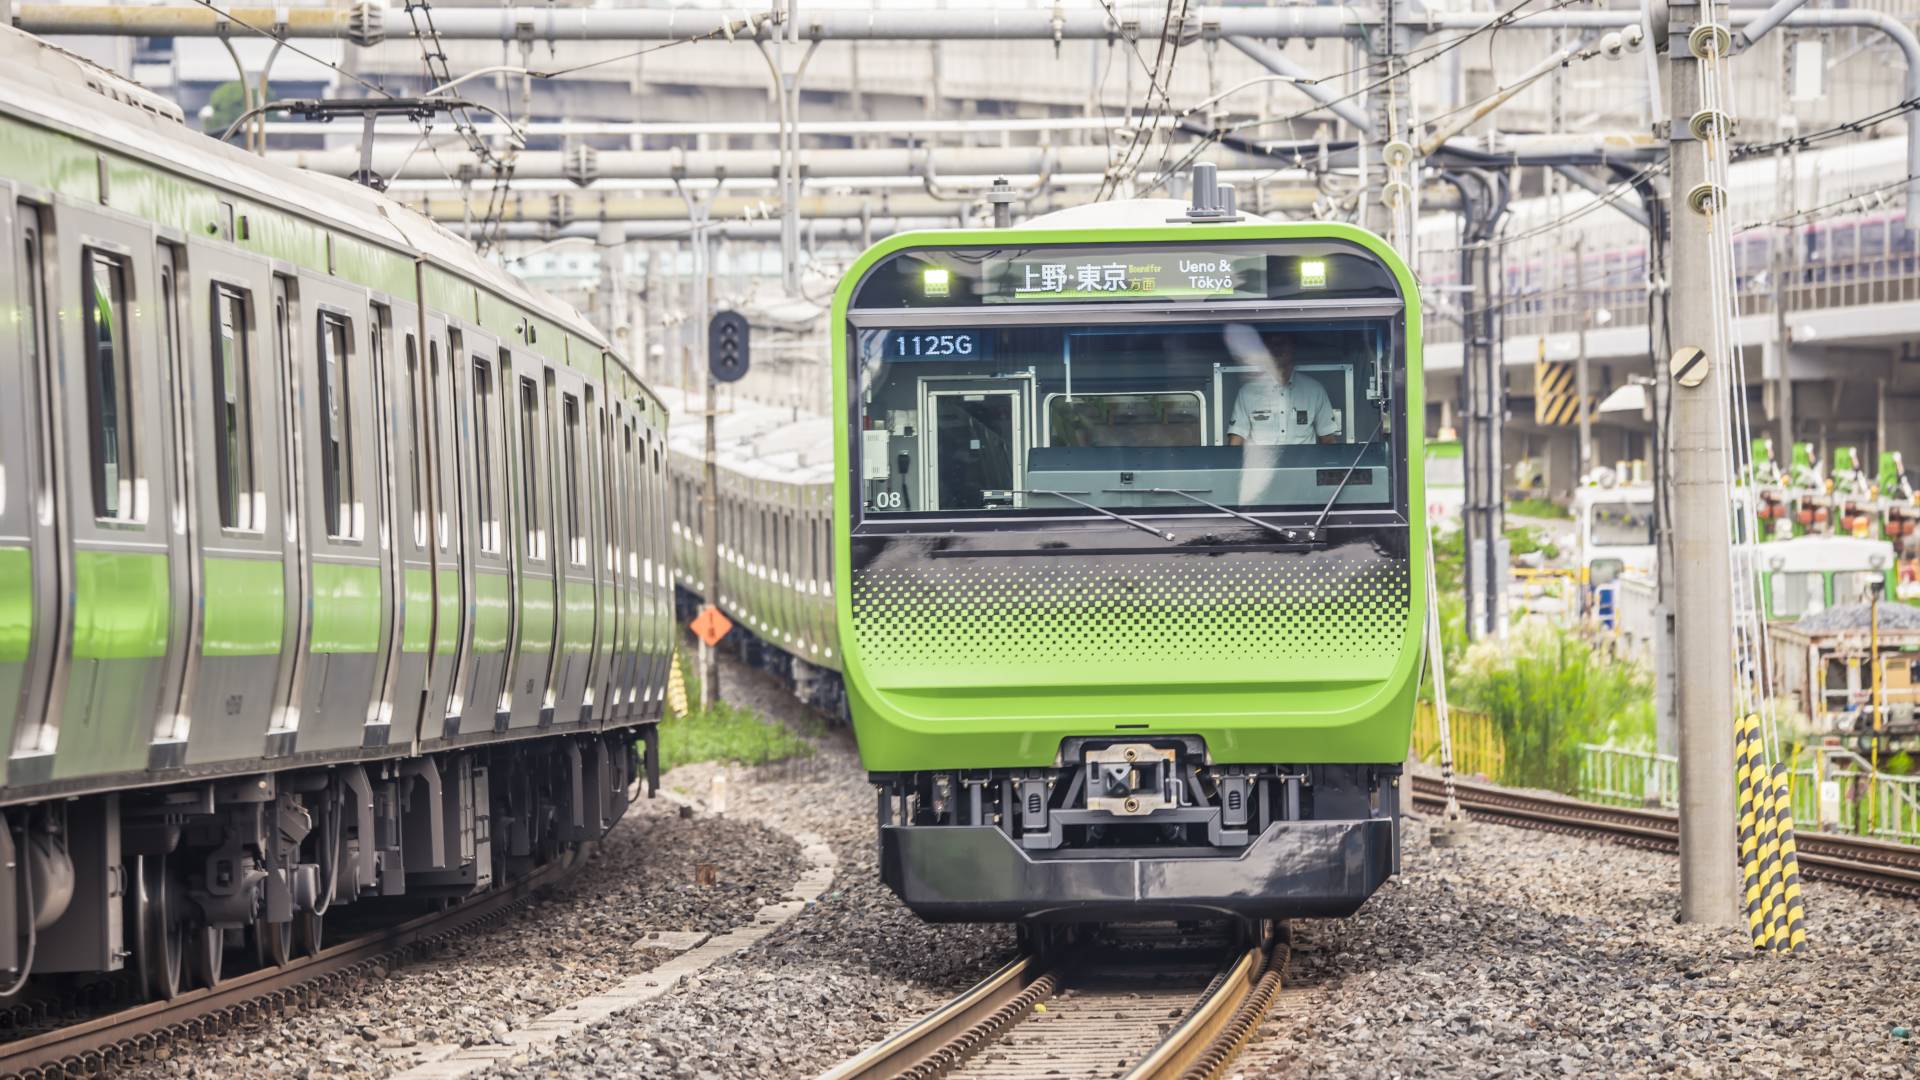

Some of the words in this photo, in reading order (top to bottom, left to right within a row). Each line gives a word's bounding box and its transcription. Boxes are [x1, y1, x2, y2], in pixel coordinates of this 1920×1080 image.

[1179, 260, 1216, 273] Ueno
[1219, 259, 1233, 273] &
[1188, 275, 1233, 292] Tōkyō
[896, 335, 973, 356] 1125G
[876, 492, 901, 508] 08
